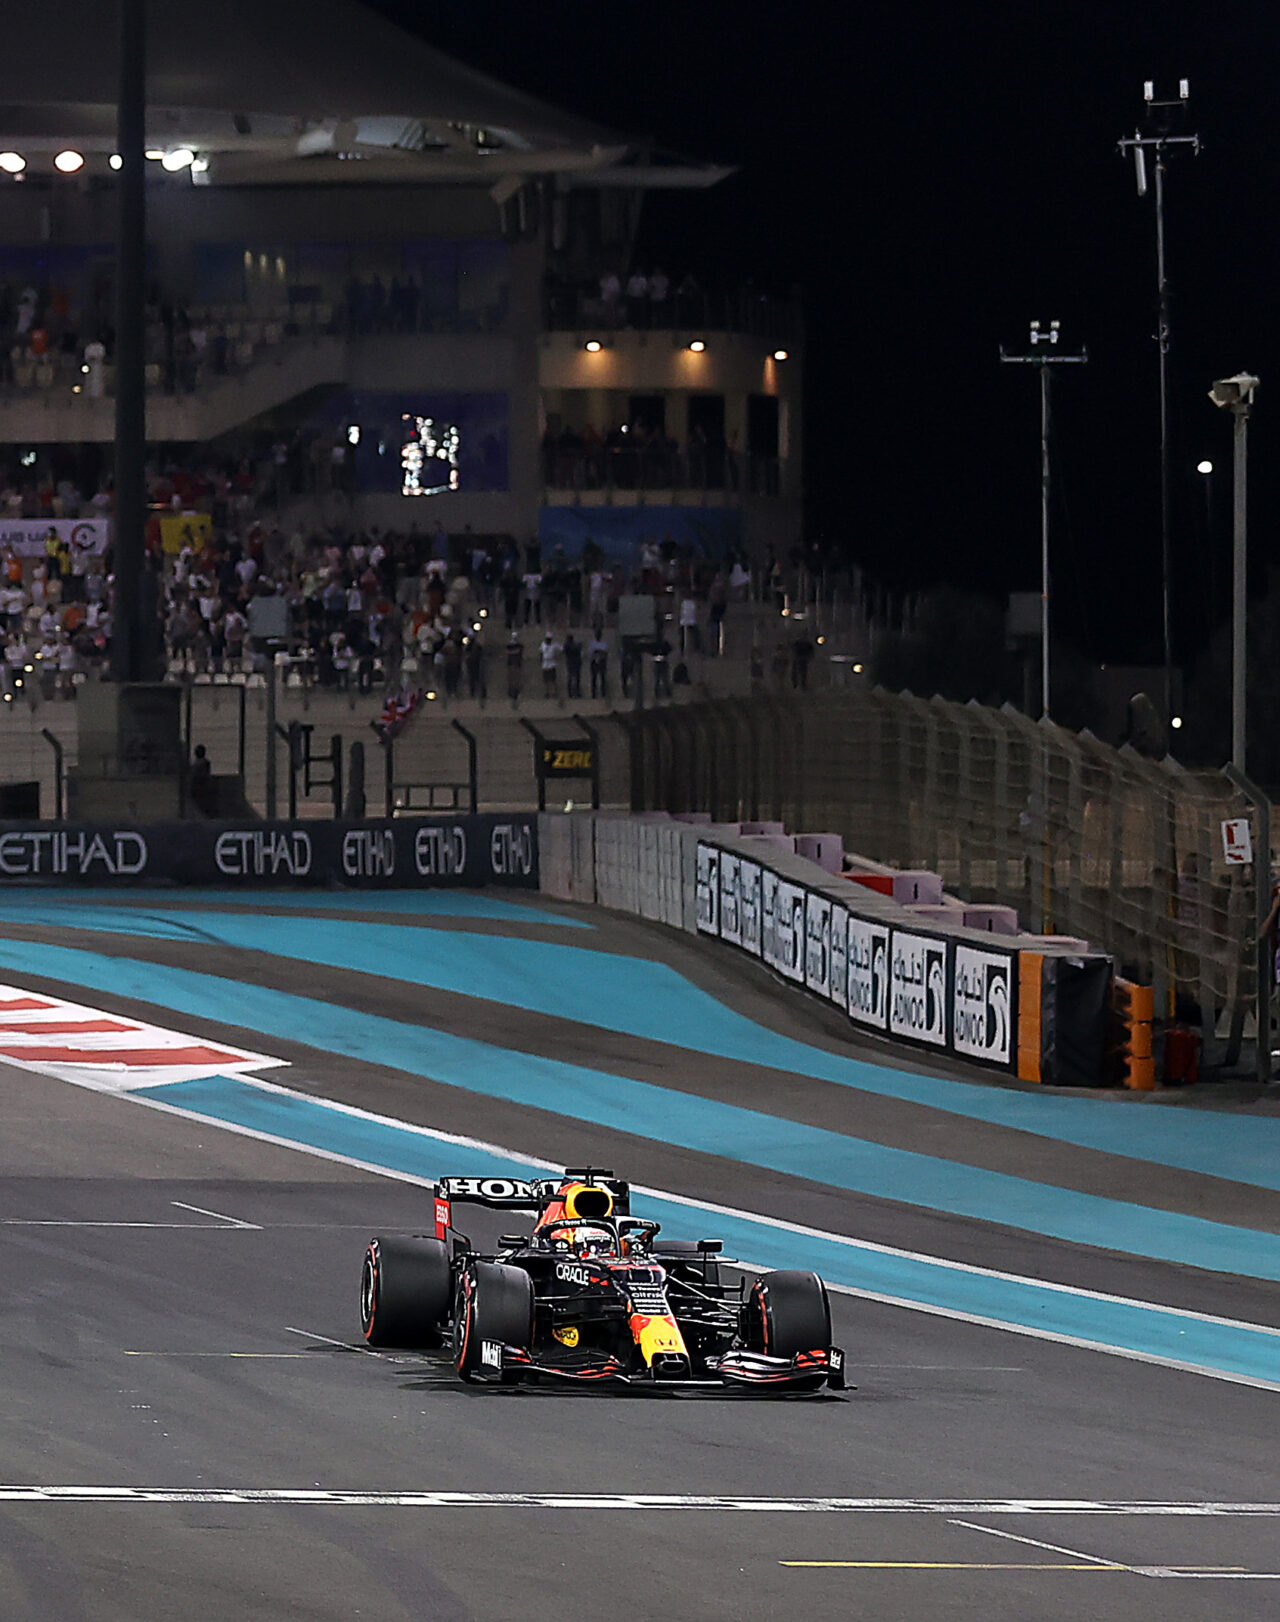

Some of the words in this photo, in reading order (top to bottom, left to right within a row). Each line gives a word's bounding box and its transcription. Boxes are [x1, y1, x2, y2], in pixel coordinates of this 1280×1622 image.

[215, 830, 311, 875] ETIHAD
[892, 993, 924, 1029] ADNOC
[955, 1008, 984, 1047] ADNOC
[556, 1264, 590, 1286] ORACLE
